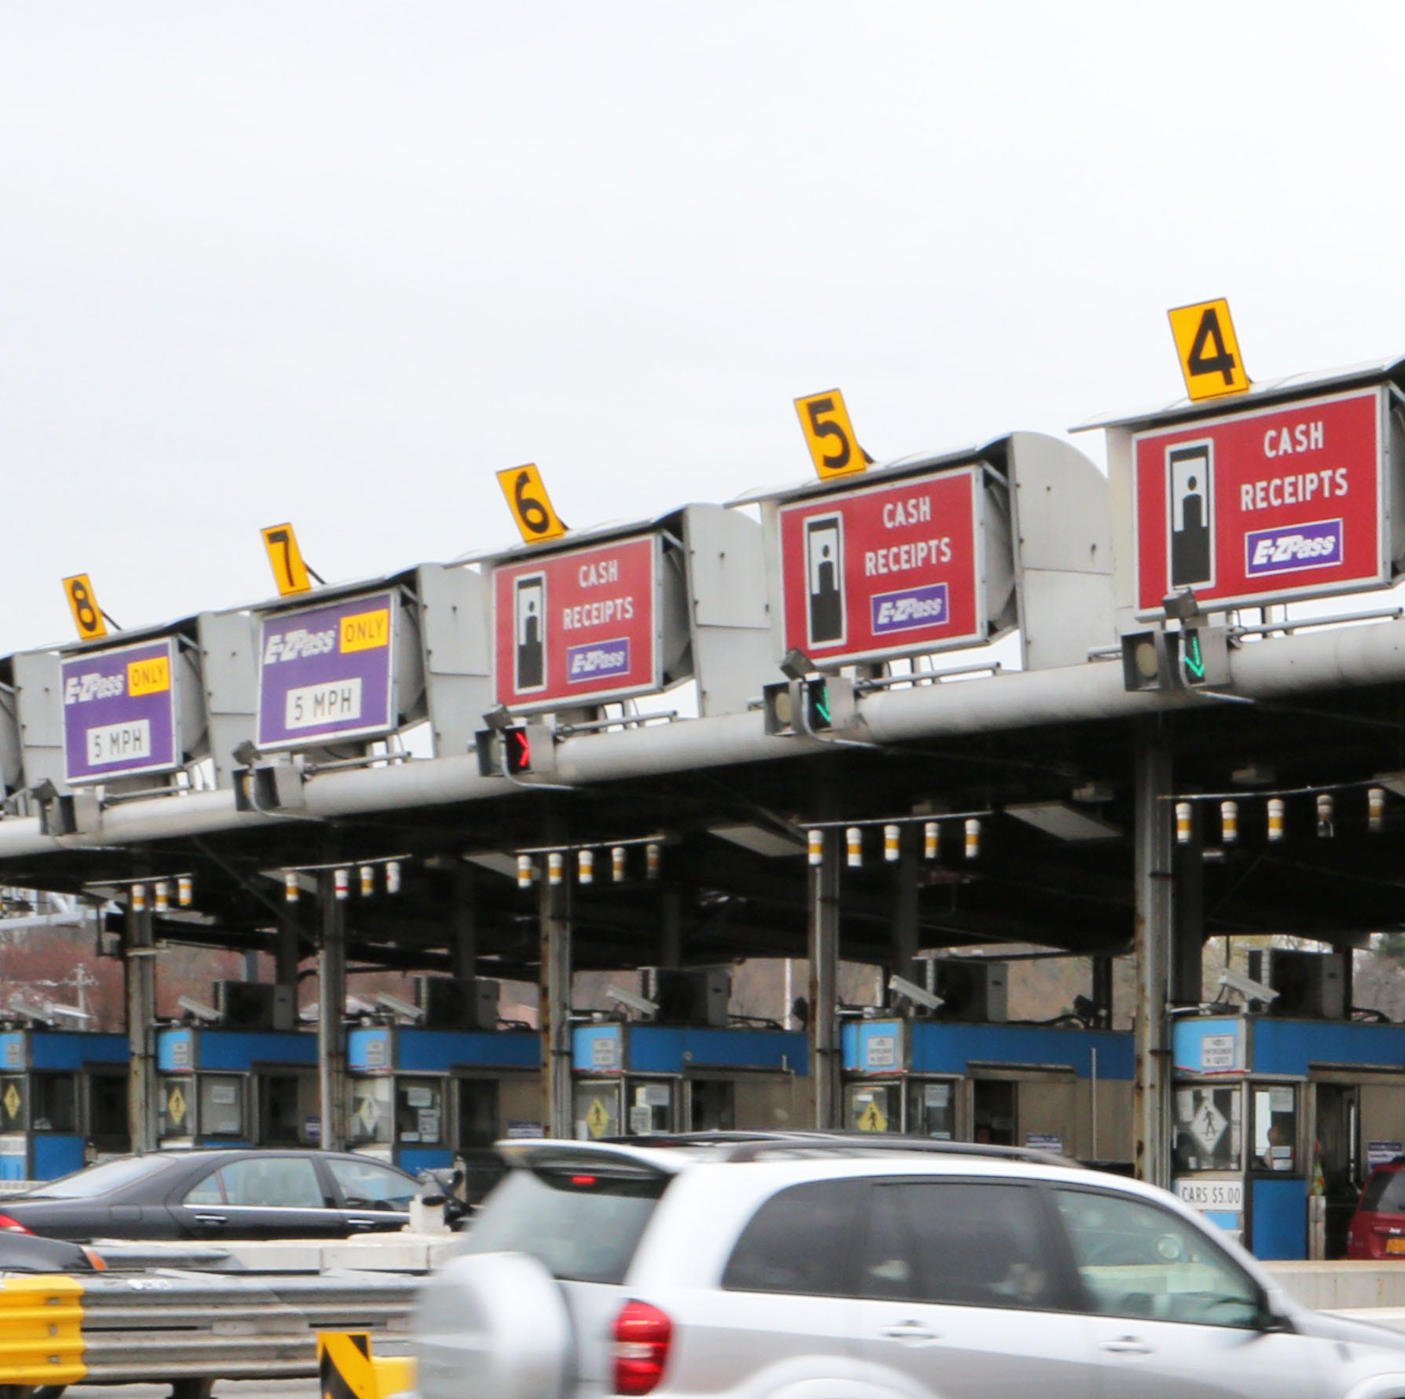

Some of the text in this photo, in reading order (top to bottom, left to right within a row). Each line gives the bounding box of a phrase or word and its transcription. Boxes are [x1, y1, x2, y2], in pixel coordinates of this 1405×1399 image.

[1187, 308, 1236, 386] 4
[807, 397, 851, 469] 5
[1263, 421, 1324, 458] CASH
[514, 470, 550, 534] 6
[1240, 467, 1349, 512] RECEIPTS
[882, 496, 931, 529] CASH
[267, 529, 295, 587] 7
[864, 537, 952, 577] RECEIPTS
[1252, 533, 1336, 566] E-ZPass
[579, 559, 619, 588] CASH
[71, 579, 98, 632] 8
[563, 597, 634, 631] RECEIPTS
[877, 597, 942, 625] E-ZPass
[344, 618, 384, 644] ONLY
[131, 662, 166, 688] ONLY
[294, 688, 352, 721] 5 MPH
[93, 728, 143, 759] 5 MPH
[1181, 1185, 1241, 1204] CARS $5.00
